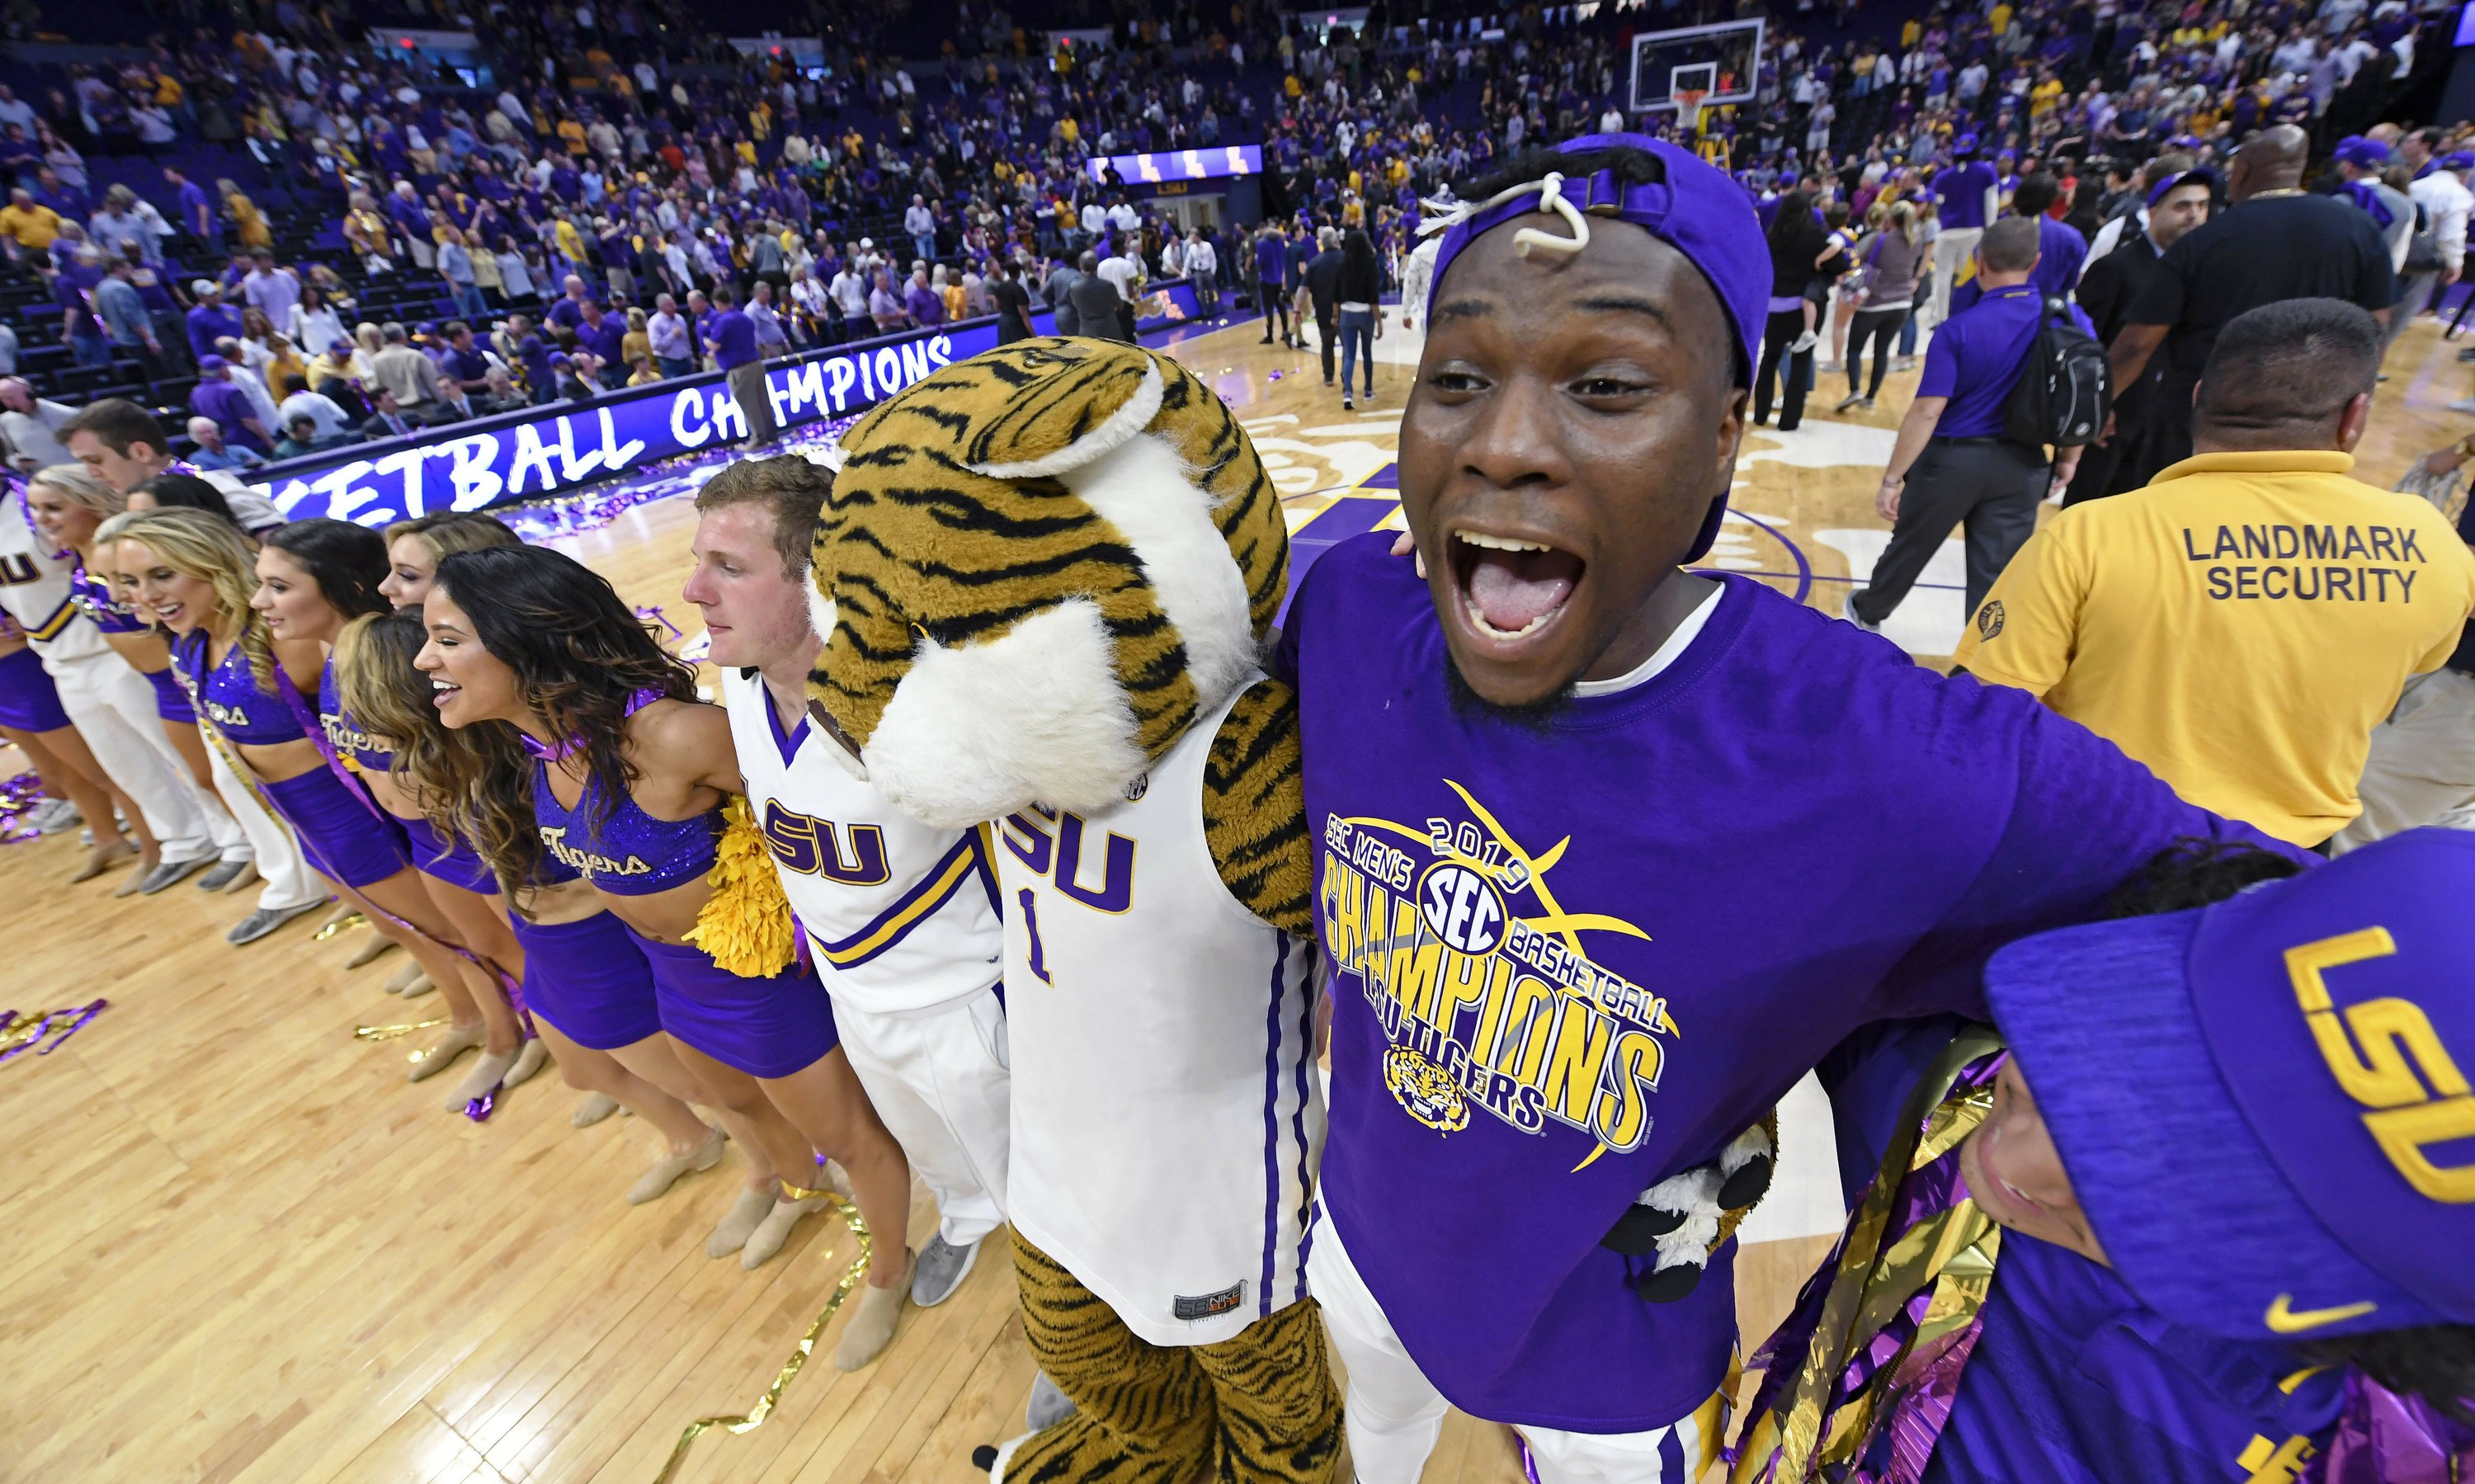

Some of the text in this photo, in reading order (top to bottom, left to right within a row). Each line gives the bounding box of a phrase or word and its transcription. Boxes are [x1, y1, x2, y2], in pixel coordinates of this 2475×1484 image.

[1157, 182, 1188, 196] LSU
[2184, 524, 2427, 563] LANDMARK
[2208, 566, 2416, 603] SECURITY
[540, 826, 652, 879] Tigers
[740, 773, 892, 887] SU
[992, 800, 1138, 916] SU
[1327, 813, 1416, 893] SEC MEN'S
[1426, 817, 1531, 895] 2019
[1016, 885, 1054, 989] 1
[1423, 867, 1501, 952] SEC
[1320, 850, 1666, 1154] CHAMPIONS
[1505, 916, 1667, 1034] BASKETBALL
[1362, 958, 1549, 1135] LSU TIGERS
[1210, 1287, 1240, 1303] NIKE
